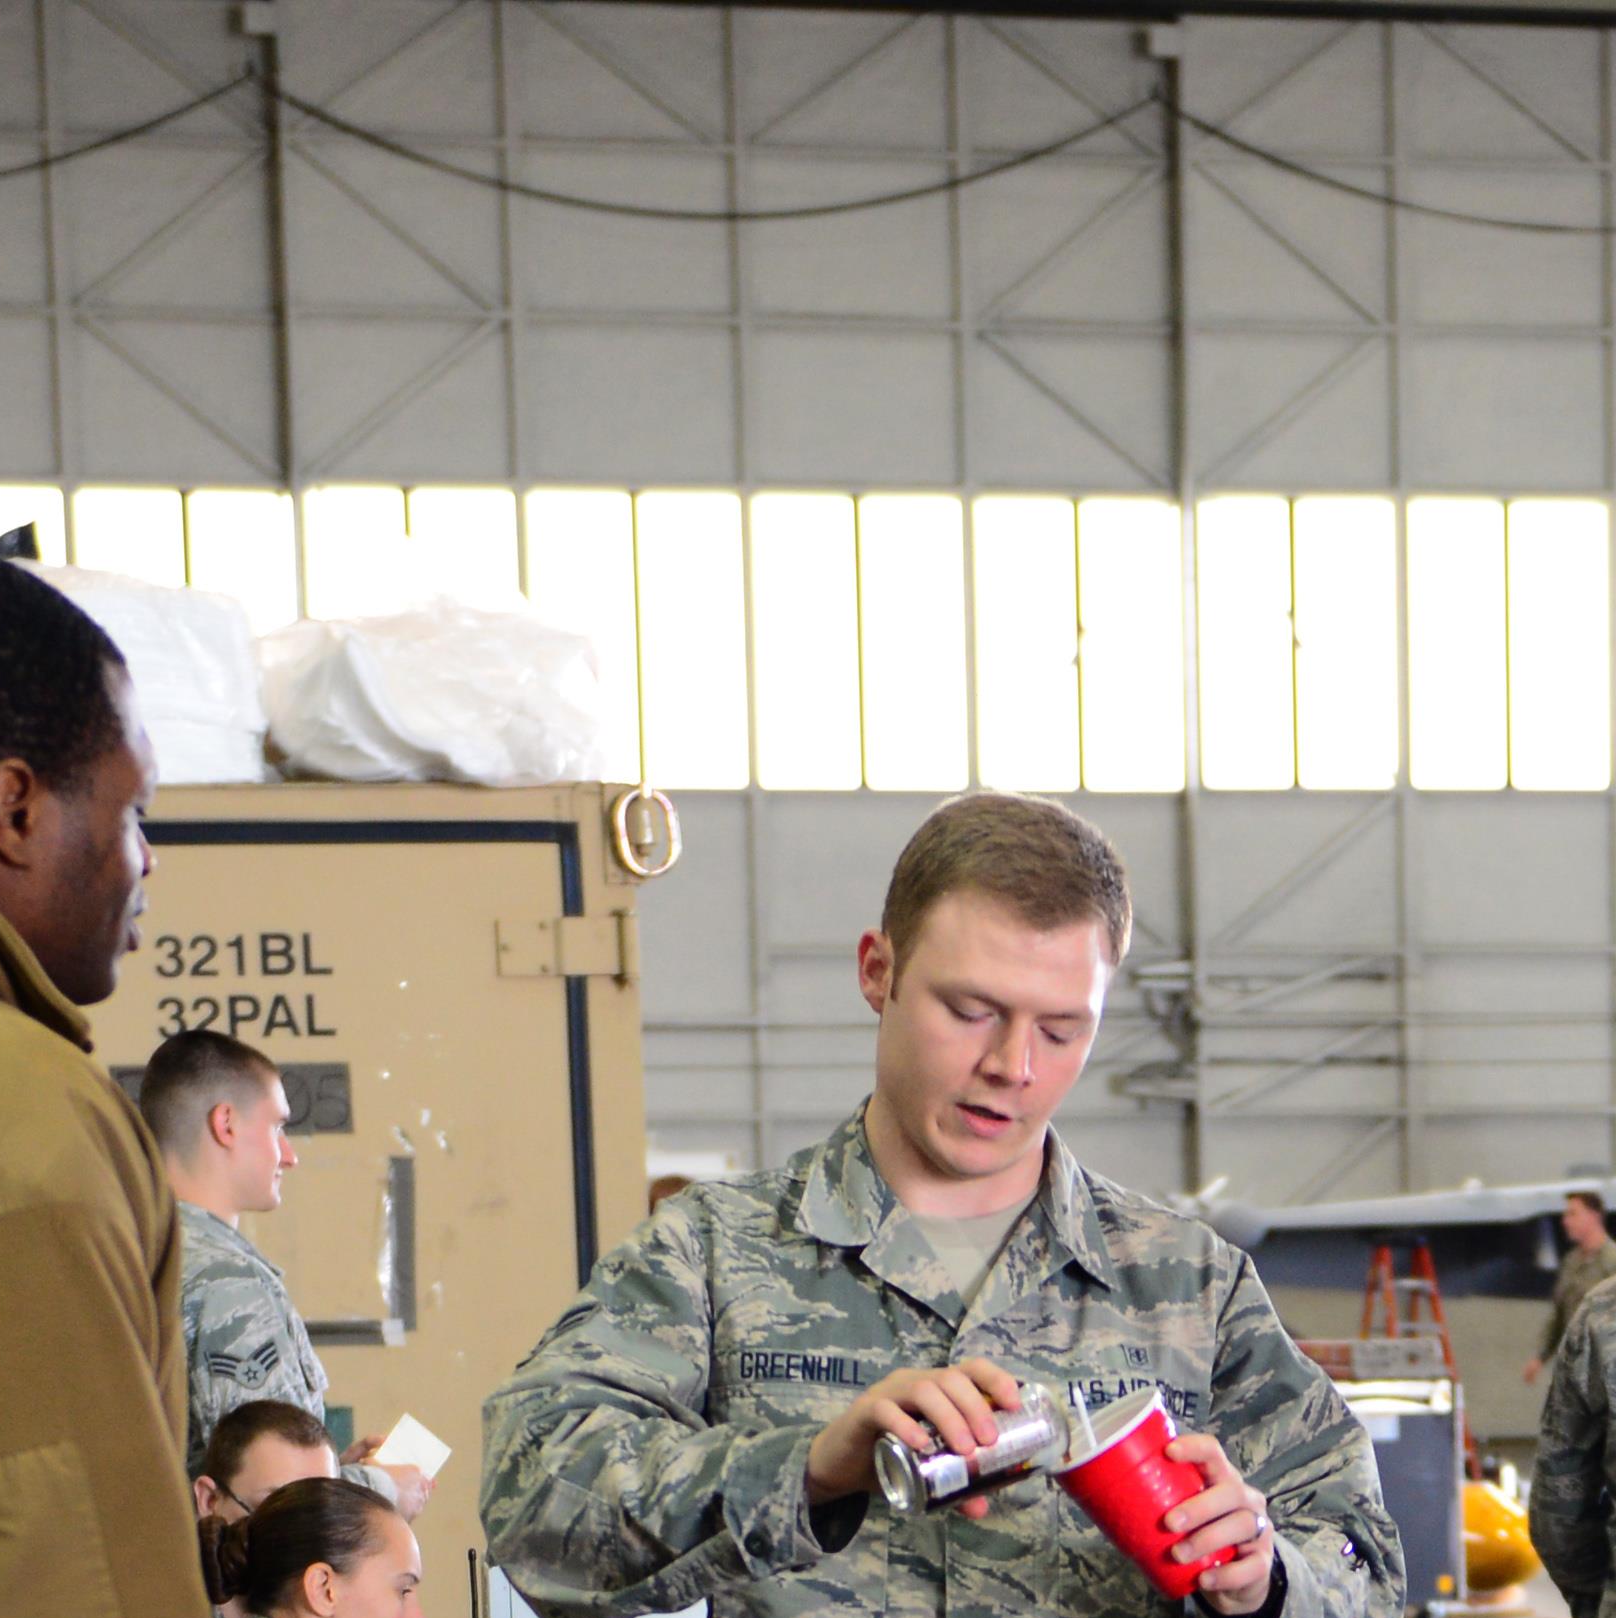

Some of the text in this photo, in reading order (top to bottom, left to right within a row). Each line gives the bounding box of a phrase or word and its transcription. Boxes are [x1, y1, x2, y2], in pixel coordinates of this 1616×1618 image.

[154, 932, 333, 977] 321BL
[157, 993, 338, 1038] 32PAL
[740, 1351, 866, 1386] GREENHILL
